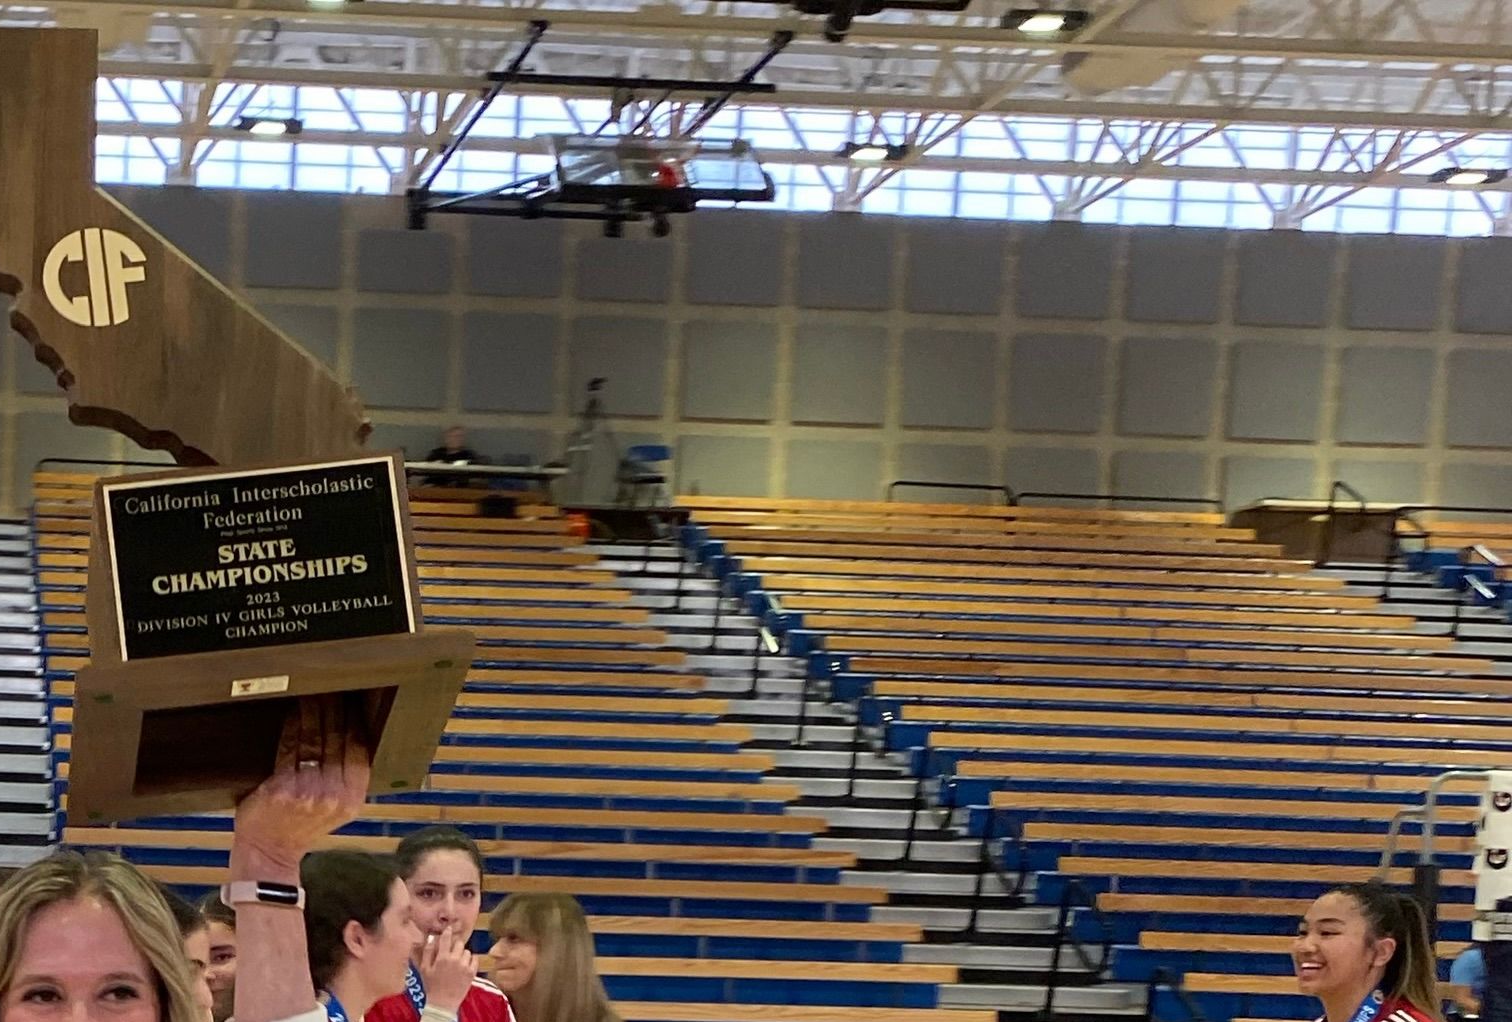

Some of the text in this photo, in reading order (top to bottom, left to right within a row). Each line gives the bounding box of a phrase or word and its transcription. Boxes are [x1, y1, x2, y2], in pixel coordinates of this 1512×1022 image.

[43, 228, 147, 327] CIF
[125, 474, 375, 514] California Interscholastic
[203, 505, 303, 529] Federation
[218, 538, 296, 564] STATE
[152, 554, 368, 595] CHAMPIONSHIPS
[137, 595, 393, 634] DIVISION IV GIRLS VOLLEYBALL
[246, 592, 280, 605] 2023
[225, 619, 308, 638] CHAMPION
